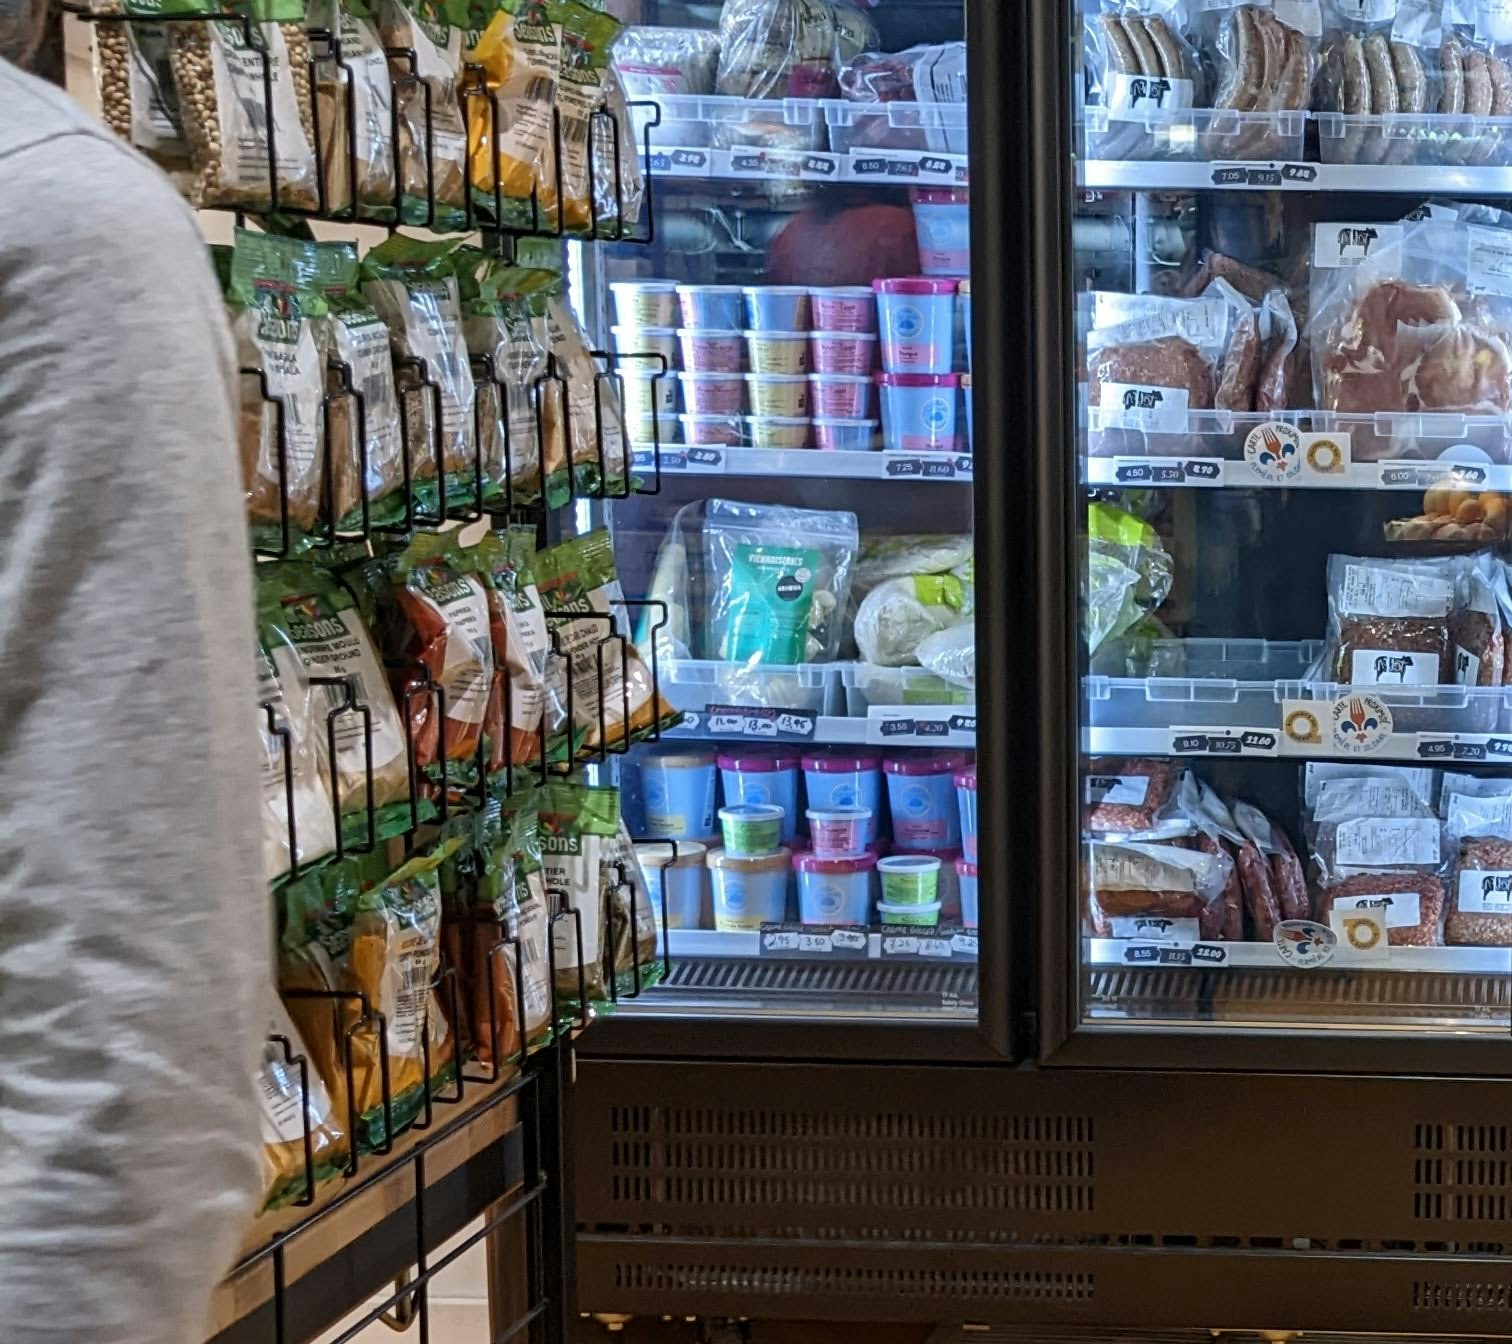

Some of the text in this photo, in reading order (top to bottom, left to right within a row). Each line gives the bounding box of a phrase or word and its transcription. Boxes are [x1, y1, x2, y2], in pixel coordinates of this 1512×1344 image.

[1248, 433, 1262, 455] CARTE
[1333, 701, 1348, 721] CARTE
[539, 836, 579, 852] sons
